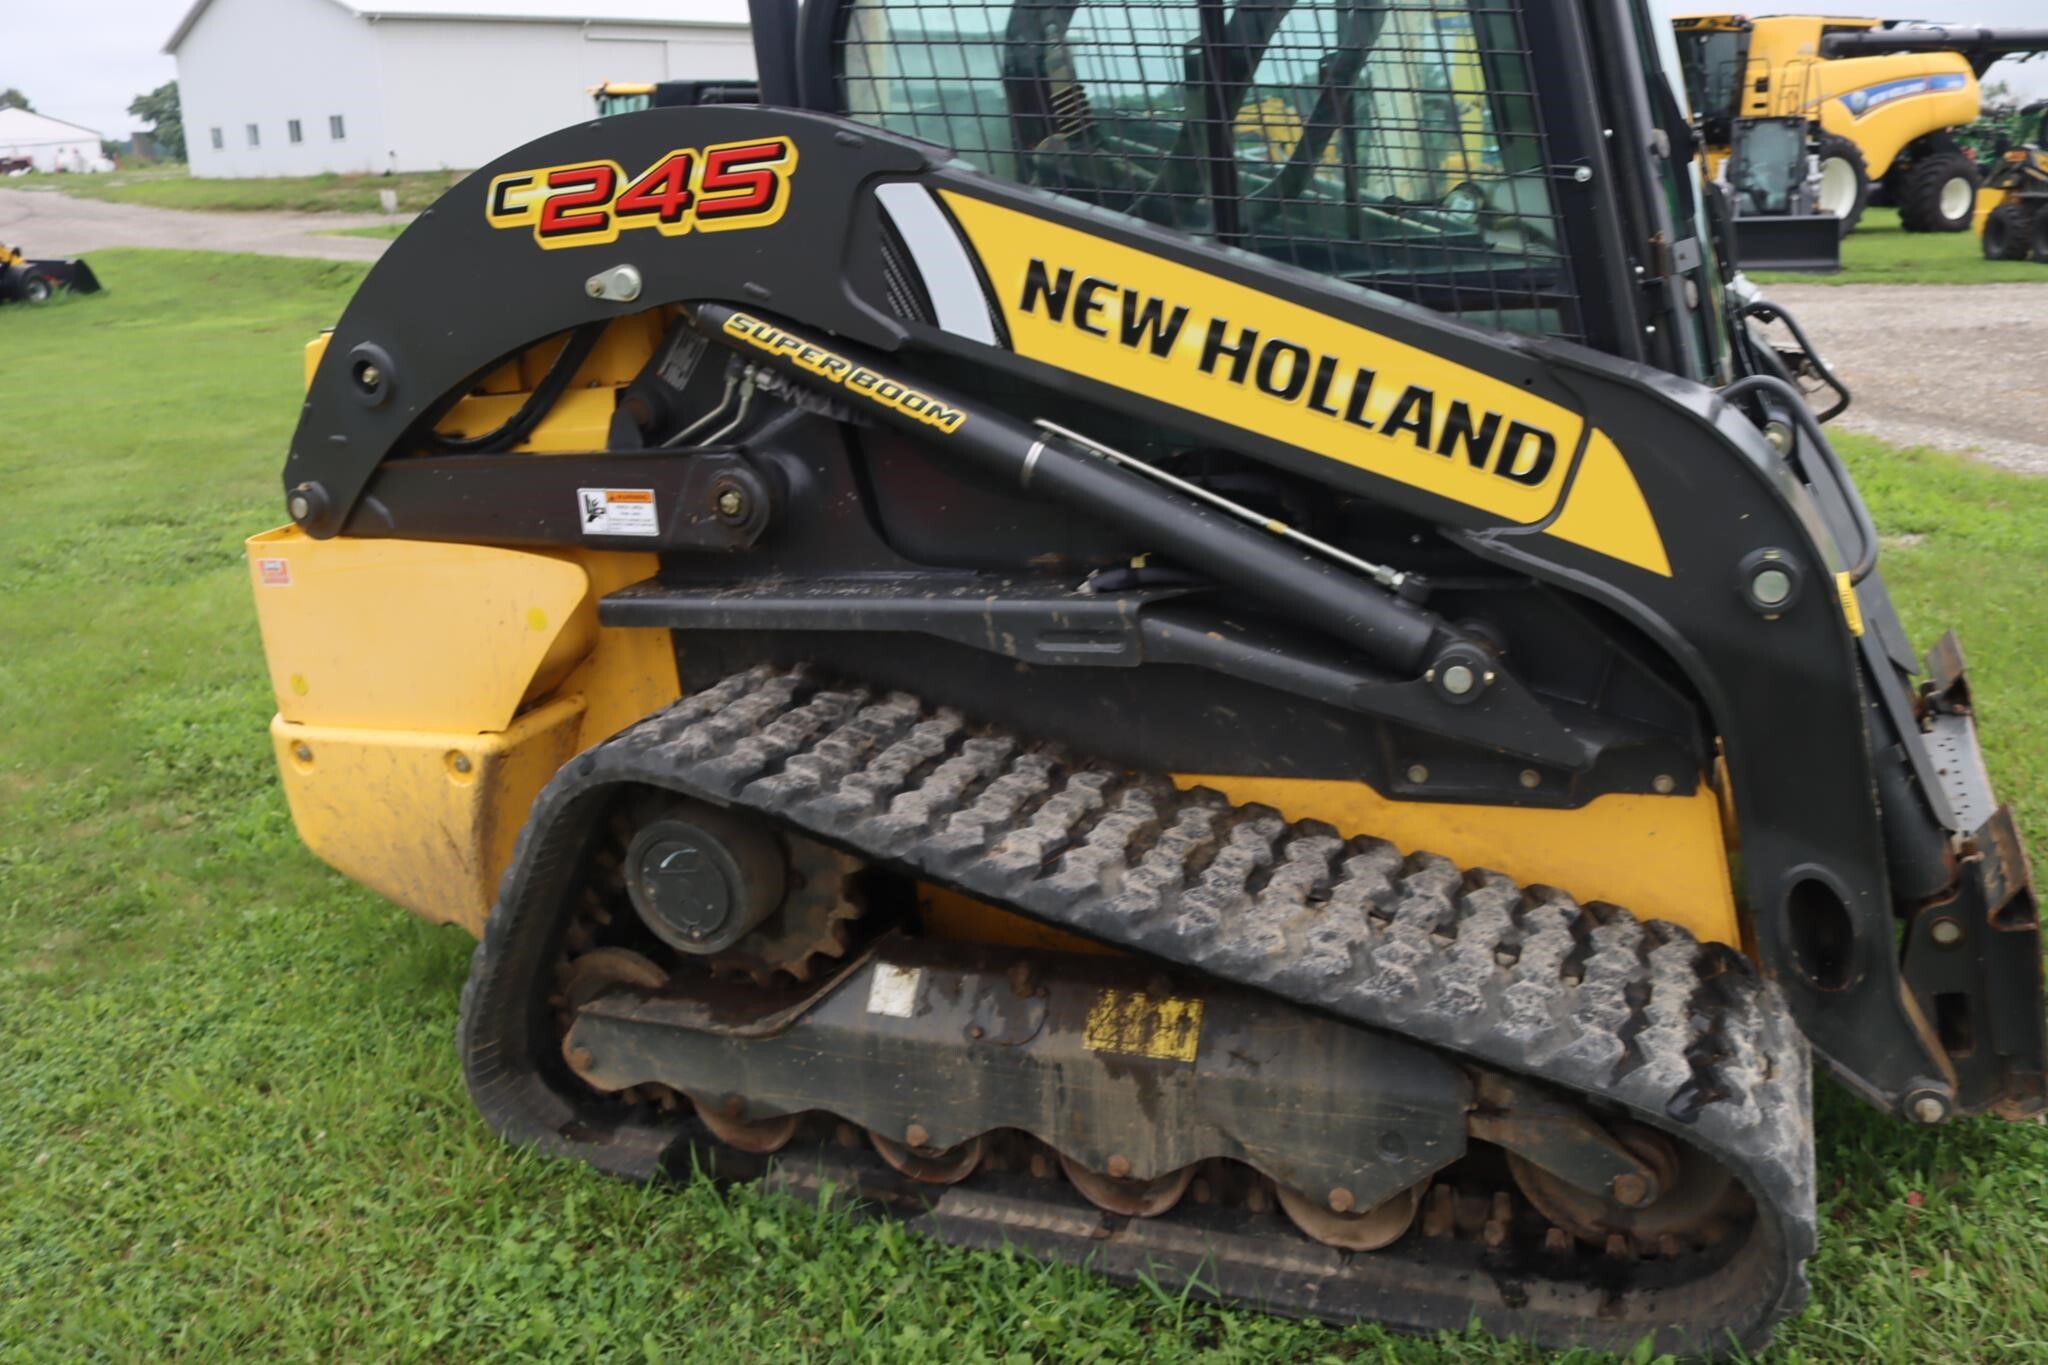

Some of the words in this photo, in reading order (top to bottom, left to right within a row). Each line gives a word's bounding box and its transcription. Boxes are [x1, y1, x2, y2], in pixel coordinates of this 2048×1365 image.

[489, 140, 793, 243] C245
[727, 315, 849, 377] SUPER
[850, 369, 964, 428] BOOM
[1020, 257, 1190, 358] NEW
[1198, 315, 1557, 487] HOLLAND
